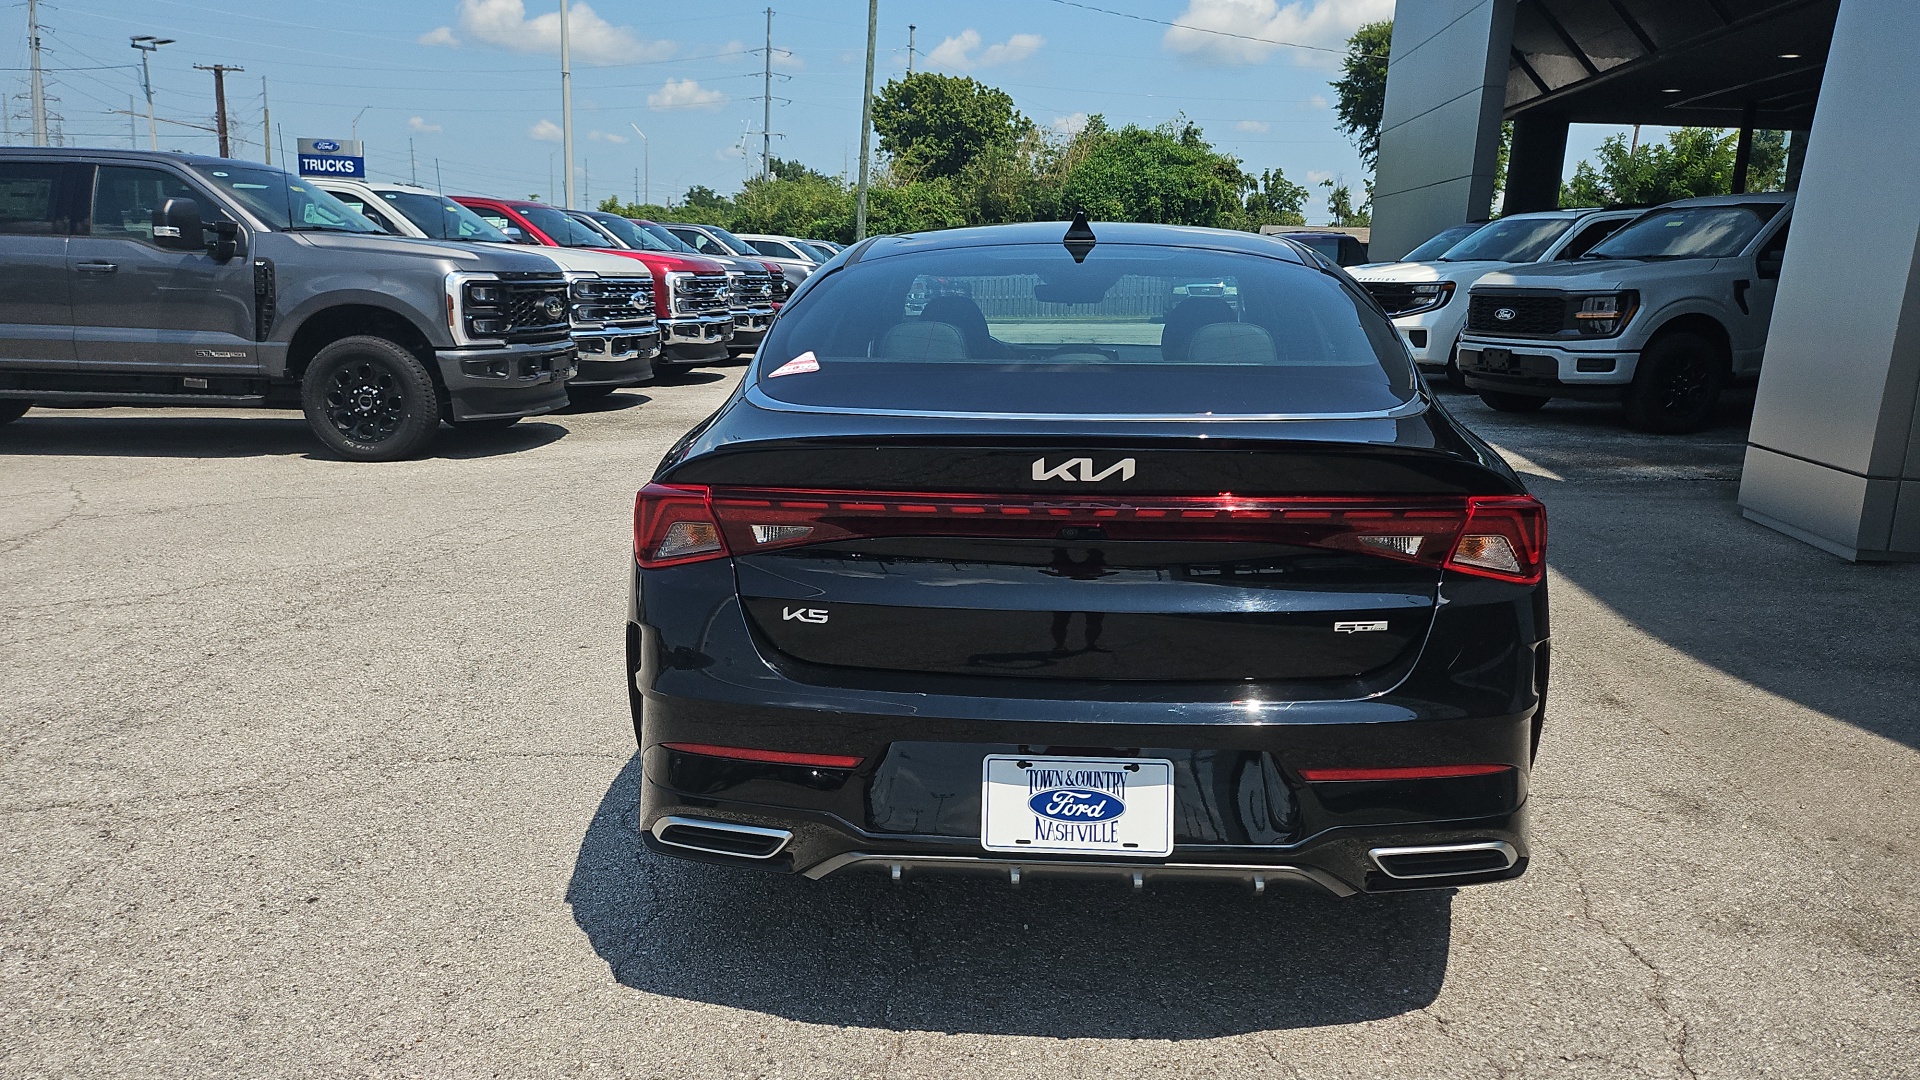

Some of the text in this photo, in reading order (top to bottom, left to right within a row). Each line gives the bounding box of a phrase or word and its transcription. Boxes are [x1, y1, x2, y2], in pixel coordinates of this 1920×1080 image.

[316, 142, 335, 150] Ford
[302, 158, 355, 173] TRUCKS
[1032, 457, 1135, 481] KIA
[783, 606, 829, 624] K5
[1026, 769, 1128, 800] TOWN & COUNTRY
[1046, 790, 1107, 818] Ford
[1035, 816, 1119, 843] NASHVILLE
